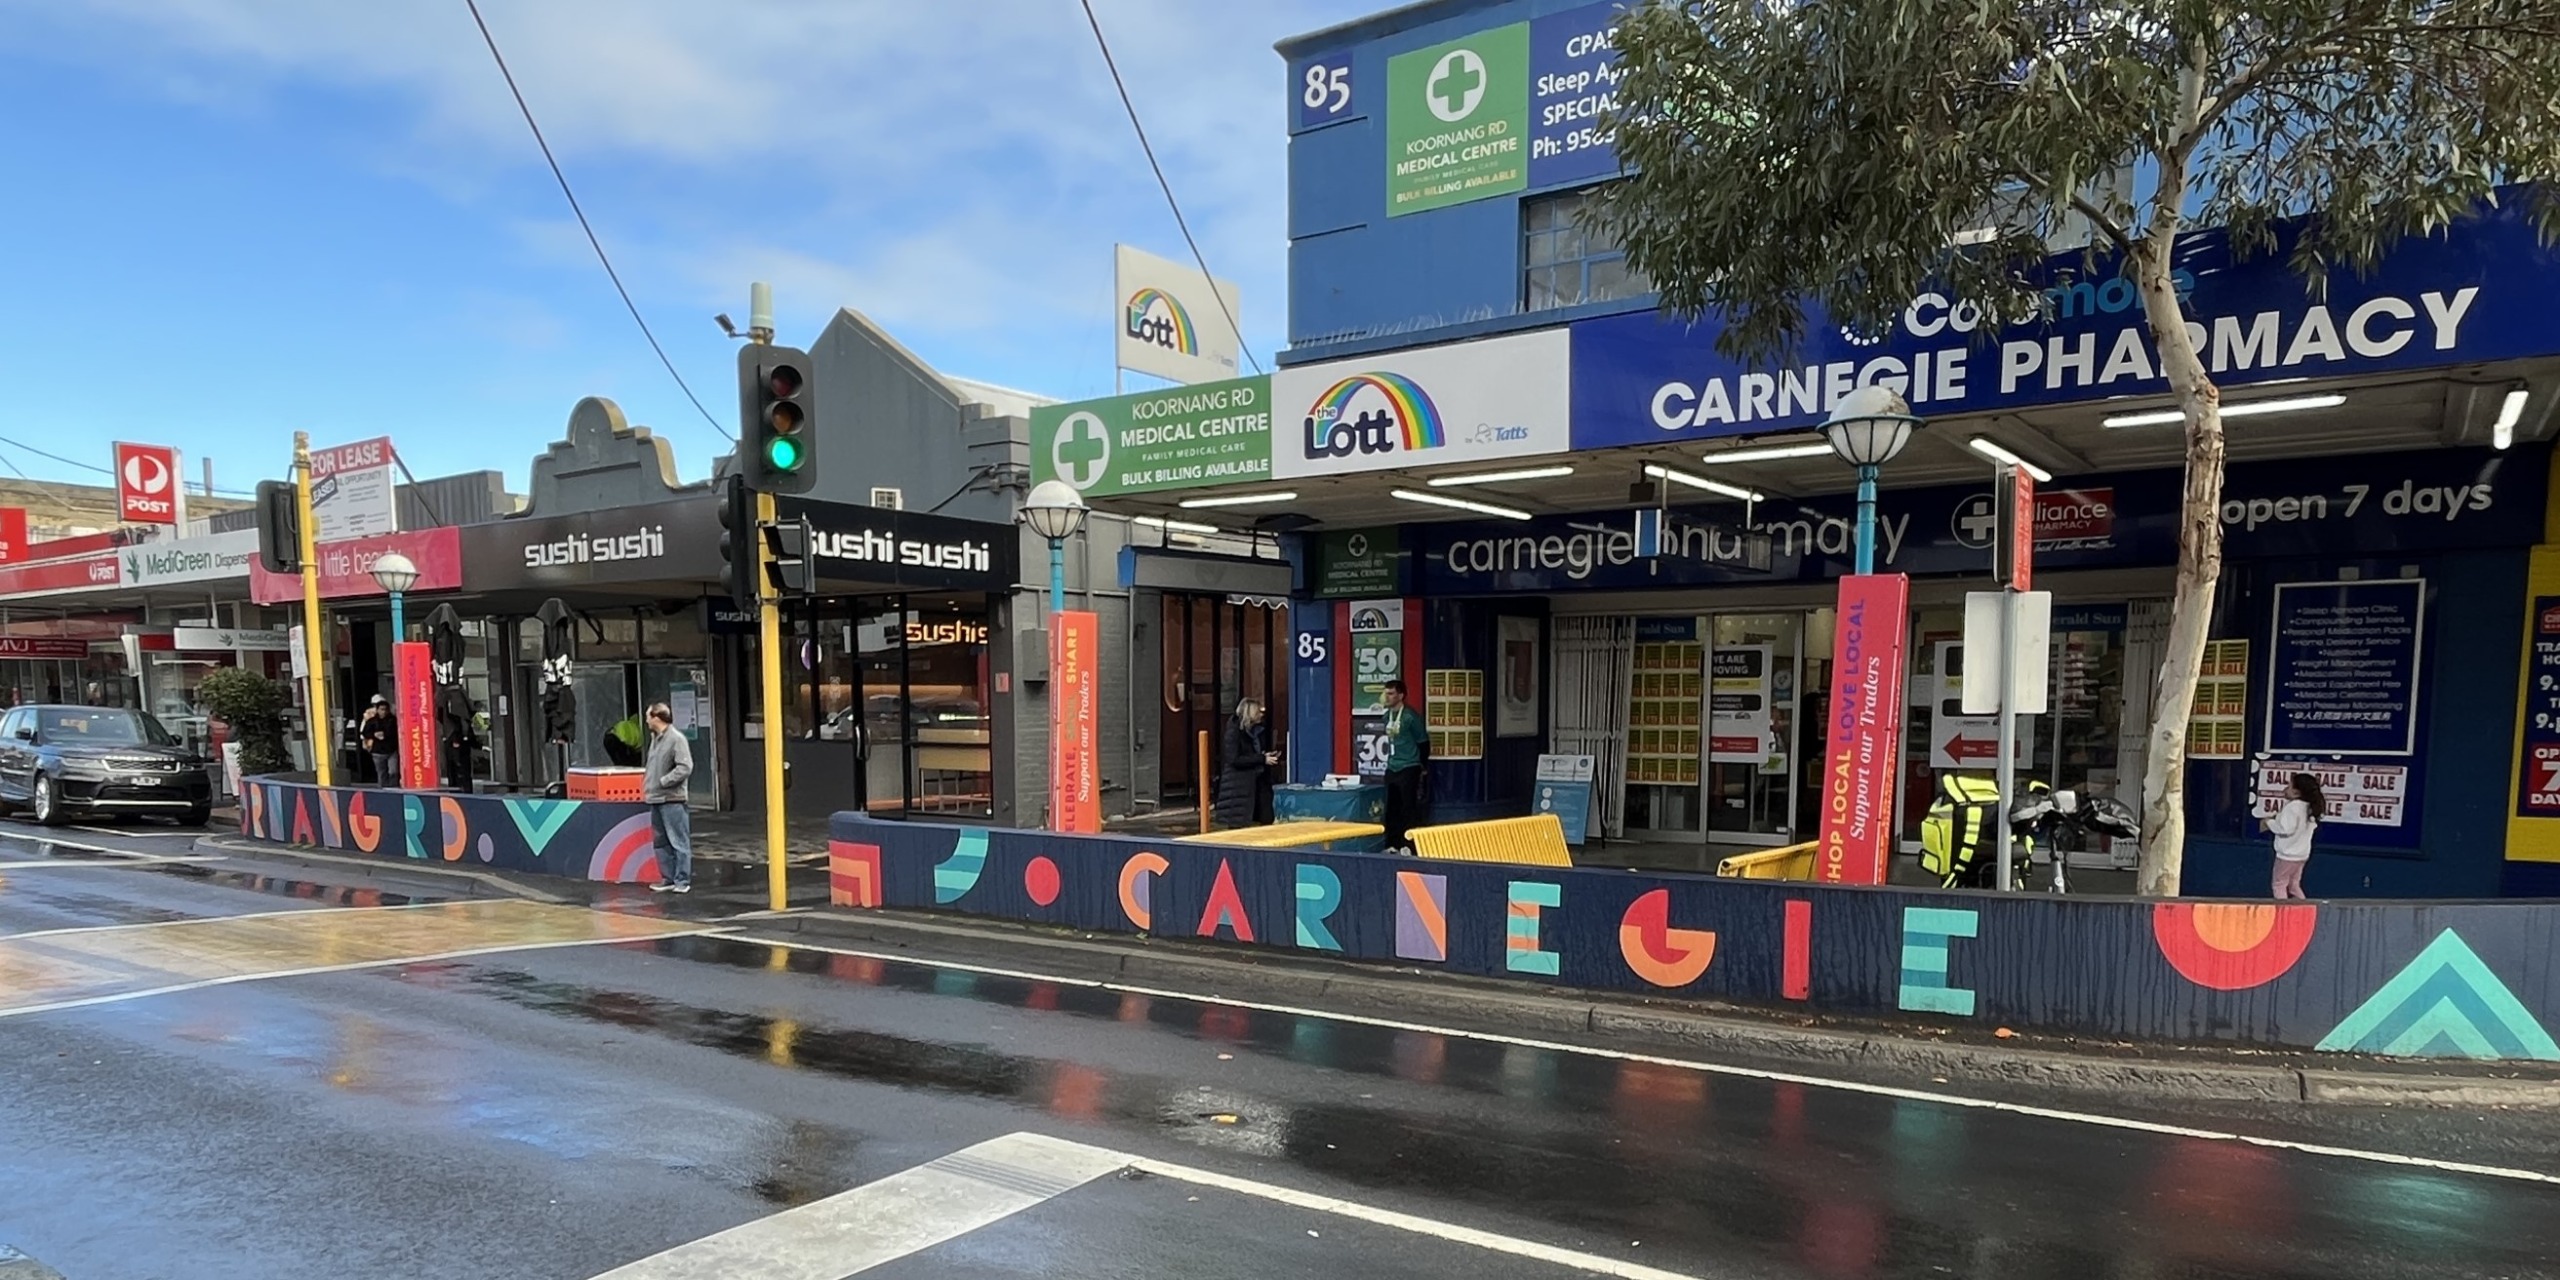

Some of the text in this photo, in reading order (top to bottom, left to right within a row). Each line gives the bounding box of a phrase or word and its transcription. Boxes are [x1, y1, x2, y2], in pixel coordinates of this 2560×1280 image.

[1304, 64, 1350, 114] 85
[1537, 70, 1590, 97] Sleep
[1543, 91, 1622, 126] SPECIAL
[1406, 120, 1507, 155] KOORNANG RD
[1532, 136, 1561, 160] Ph:
[1396, 137, 1517, 176] MEDICAL CENTRE
[1396, 169, 1517, 203] BULK BILLING AVAILABLE
[1126, 305, 1175, 349] Lott
[1132, 387, 1255, 421] KOORNANG RD
[1651, 347, 1968, 430] CARNEGIE
[1316, 405, 1336, 419] the
[1121, 413, 1269, 448] MEDICAL CENTRE
[1304, 409, 1394, 460] Lott
[1494, 426, 1528, 441] Tatts
[312, 442, 380, 475] FOR LEASE
[1142, 442, 1246, 462] FAMILY MEDICAL CARE
[1122, 458, 1269, 486] BULK BILLING AVAILABLE
[127, 499, 169, 514] POST
[312, 479, 336, 503] EASED
[2220, 479, 2493, 532] open 7 days
[2033, 500, 2108, 521] lliance
[2033, 520, 2092, 531] HARMACY
[525, 525, 664, 567] sushi sushi
[899, 540, 990, 572] sushi
[1449, 522, 1634, 580] carnegie
[97, 567, 116, 580] POST
[146, 550, 212, 576] MediGreen
[324, 550, 350, 577] little
[1352, 617, 1377, 629] Lott
[1664, 623, 1686, 634] Sun
[2052, 612, 2121, 625] erald Sun
[1297, 632, 1326, 664] 85
[1726, 654, 1746, 664] ARE
[1713, 665, 1749, 675] OVING
[419, 680, 430, 769] Support our Traders
[1065, 627, 1078, 832] ELEBRATE, SHARE
[1078, 670, 1090, 803] Support our Traders
[412, 726, 422, 763] LOCAL
[1826, 598, 1866, 884] HOP LOCAL LOVE LOCAL
[1850, 655, 1881, 841] Support our Traders
[414, 765, 423, 788] HOP
[1357, 760, 1387, 770] MILLIO
[2363, 776, 2395, 790] SALE
[2324, 803, 2343, 816] LE
[2360, 804, 2392, 819] SALE
[1118, 854, 1979, 1016] CARNEGIE
